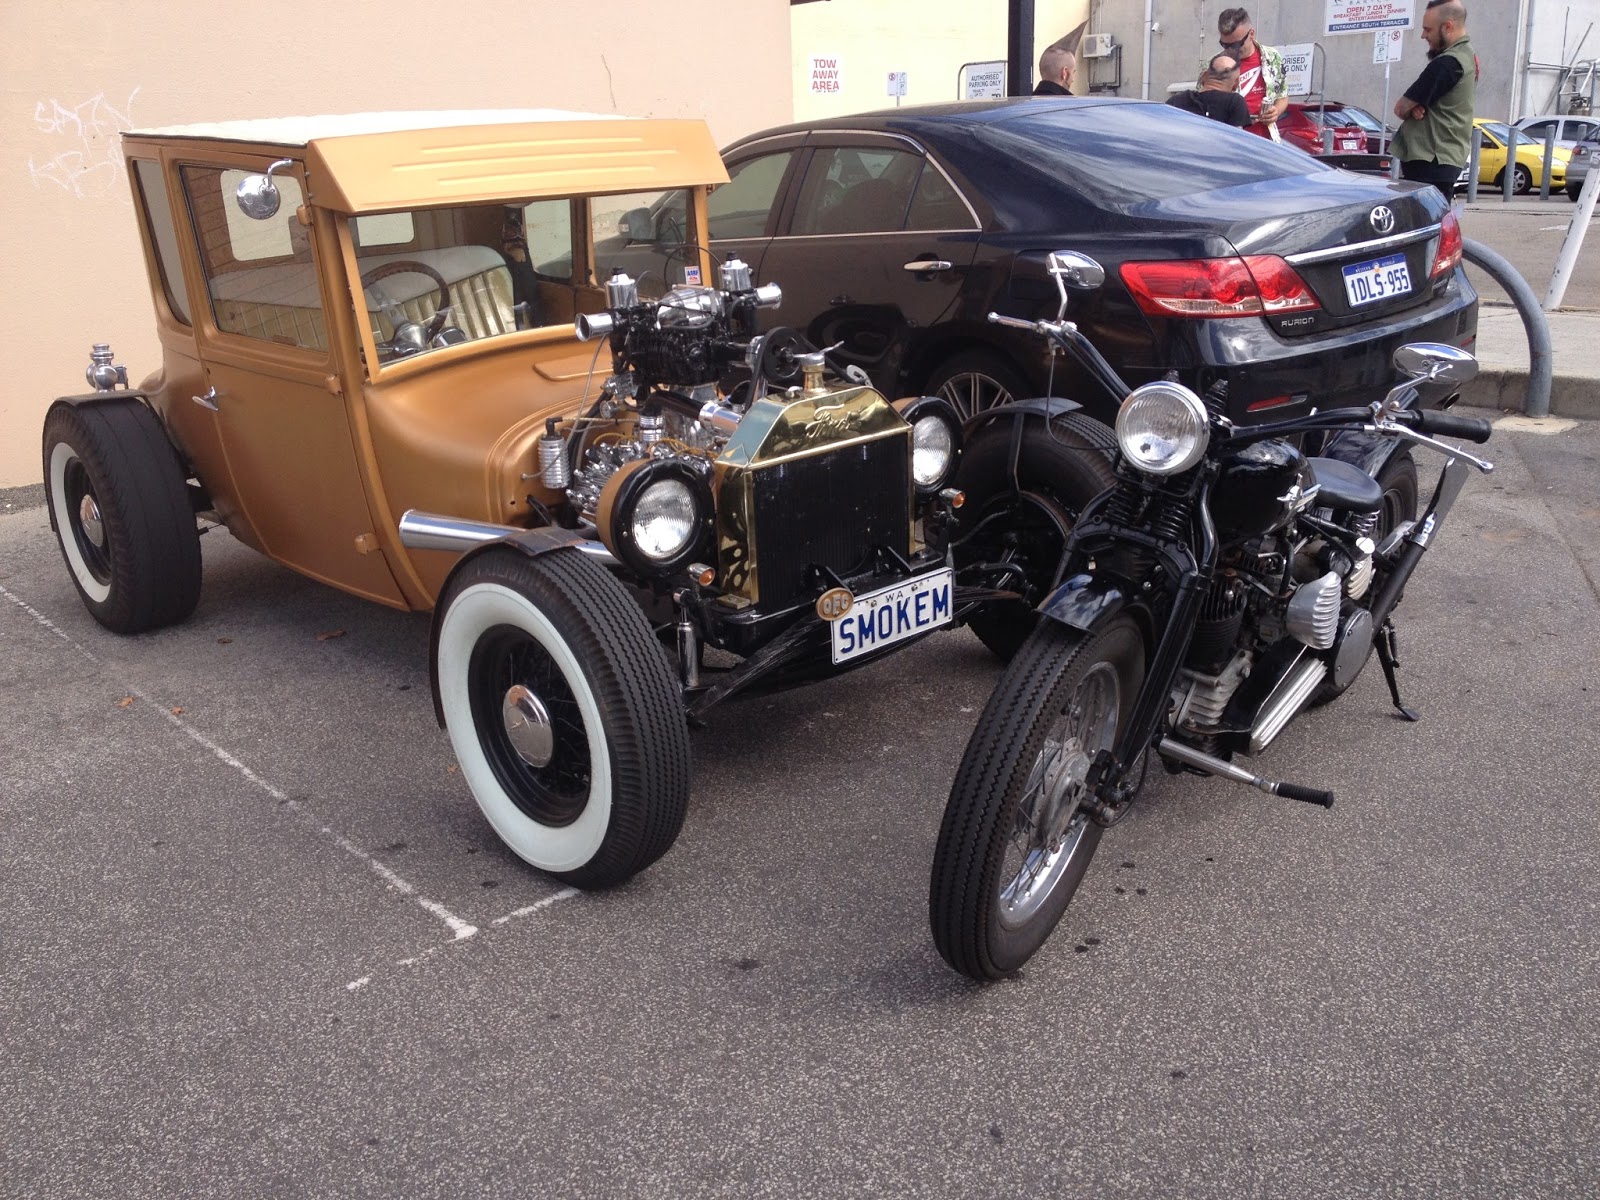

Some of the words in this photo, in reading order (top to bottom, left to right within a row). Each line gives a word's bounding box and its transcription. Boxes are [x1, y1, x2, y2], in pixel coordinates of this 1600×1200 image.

[1372, 3, 1393, 11] DAYS
[1332, 23, 1360, 31] ENTRANCE
[1380, 19, 1405, 27] TERRACE
[813, 58, 837, 69] TOW
[1282, 56, 1306, 65] ORISED
[1290, 63, 1309, 73] ONLY
[812, 69, 839, 80] AWAY
[970, 73, 1000, 82] AUTHORISED
[812, 80, 840, 90] AREA
[968, 80, 989, 88] PARKING
[989, 79, 1002, 87] ONLY
[885, 590, 904, 603] WA
[839, 583, 949, 654] SMOKEM
